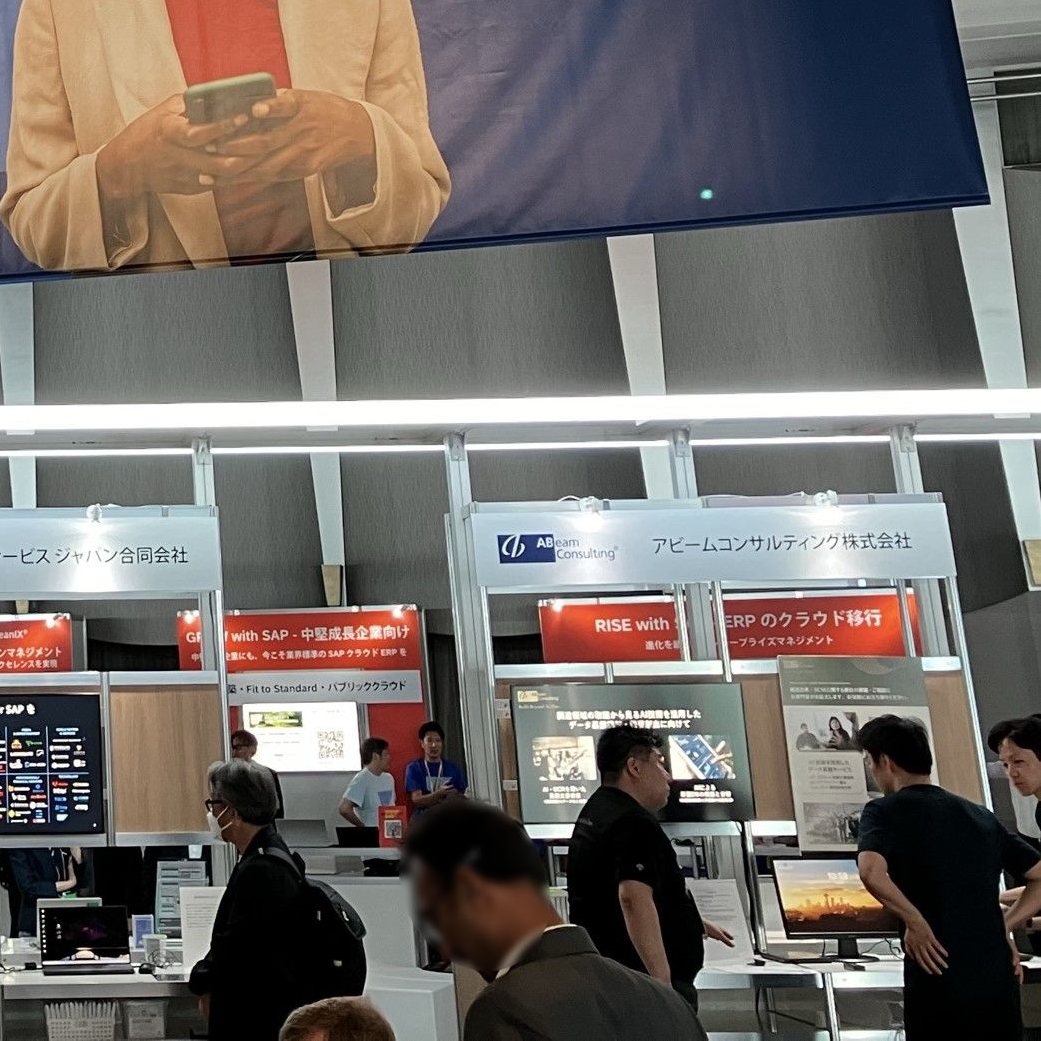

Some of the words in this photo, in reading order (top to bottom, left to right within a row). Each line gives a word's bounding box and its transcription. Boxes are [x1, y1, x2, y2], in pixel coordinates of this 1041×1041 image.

[536, 536, 580, 548] ABeam
[652, 531, 913, 555] アビームコンサルティング株式会社
[55, 546, 188, 565] ジャパン合同会社
[594, 618, 633, 633] RISE
[635, 617, 670, 632] with
[761, 609, 882, 628] のクラウド移行
[186, 630, 228, 644] GR
[231, 629, 259, 642] with
[262, 629, 289, 641] SAP
[301, 625, 410, 642] 中堅成長企業向け
[246, 683, 259, 694] Fit
[261, 684, 270, 694] to
[273, 683, 317, 694] Standard
[5, 704, 25, 715] SAP
